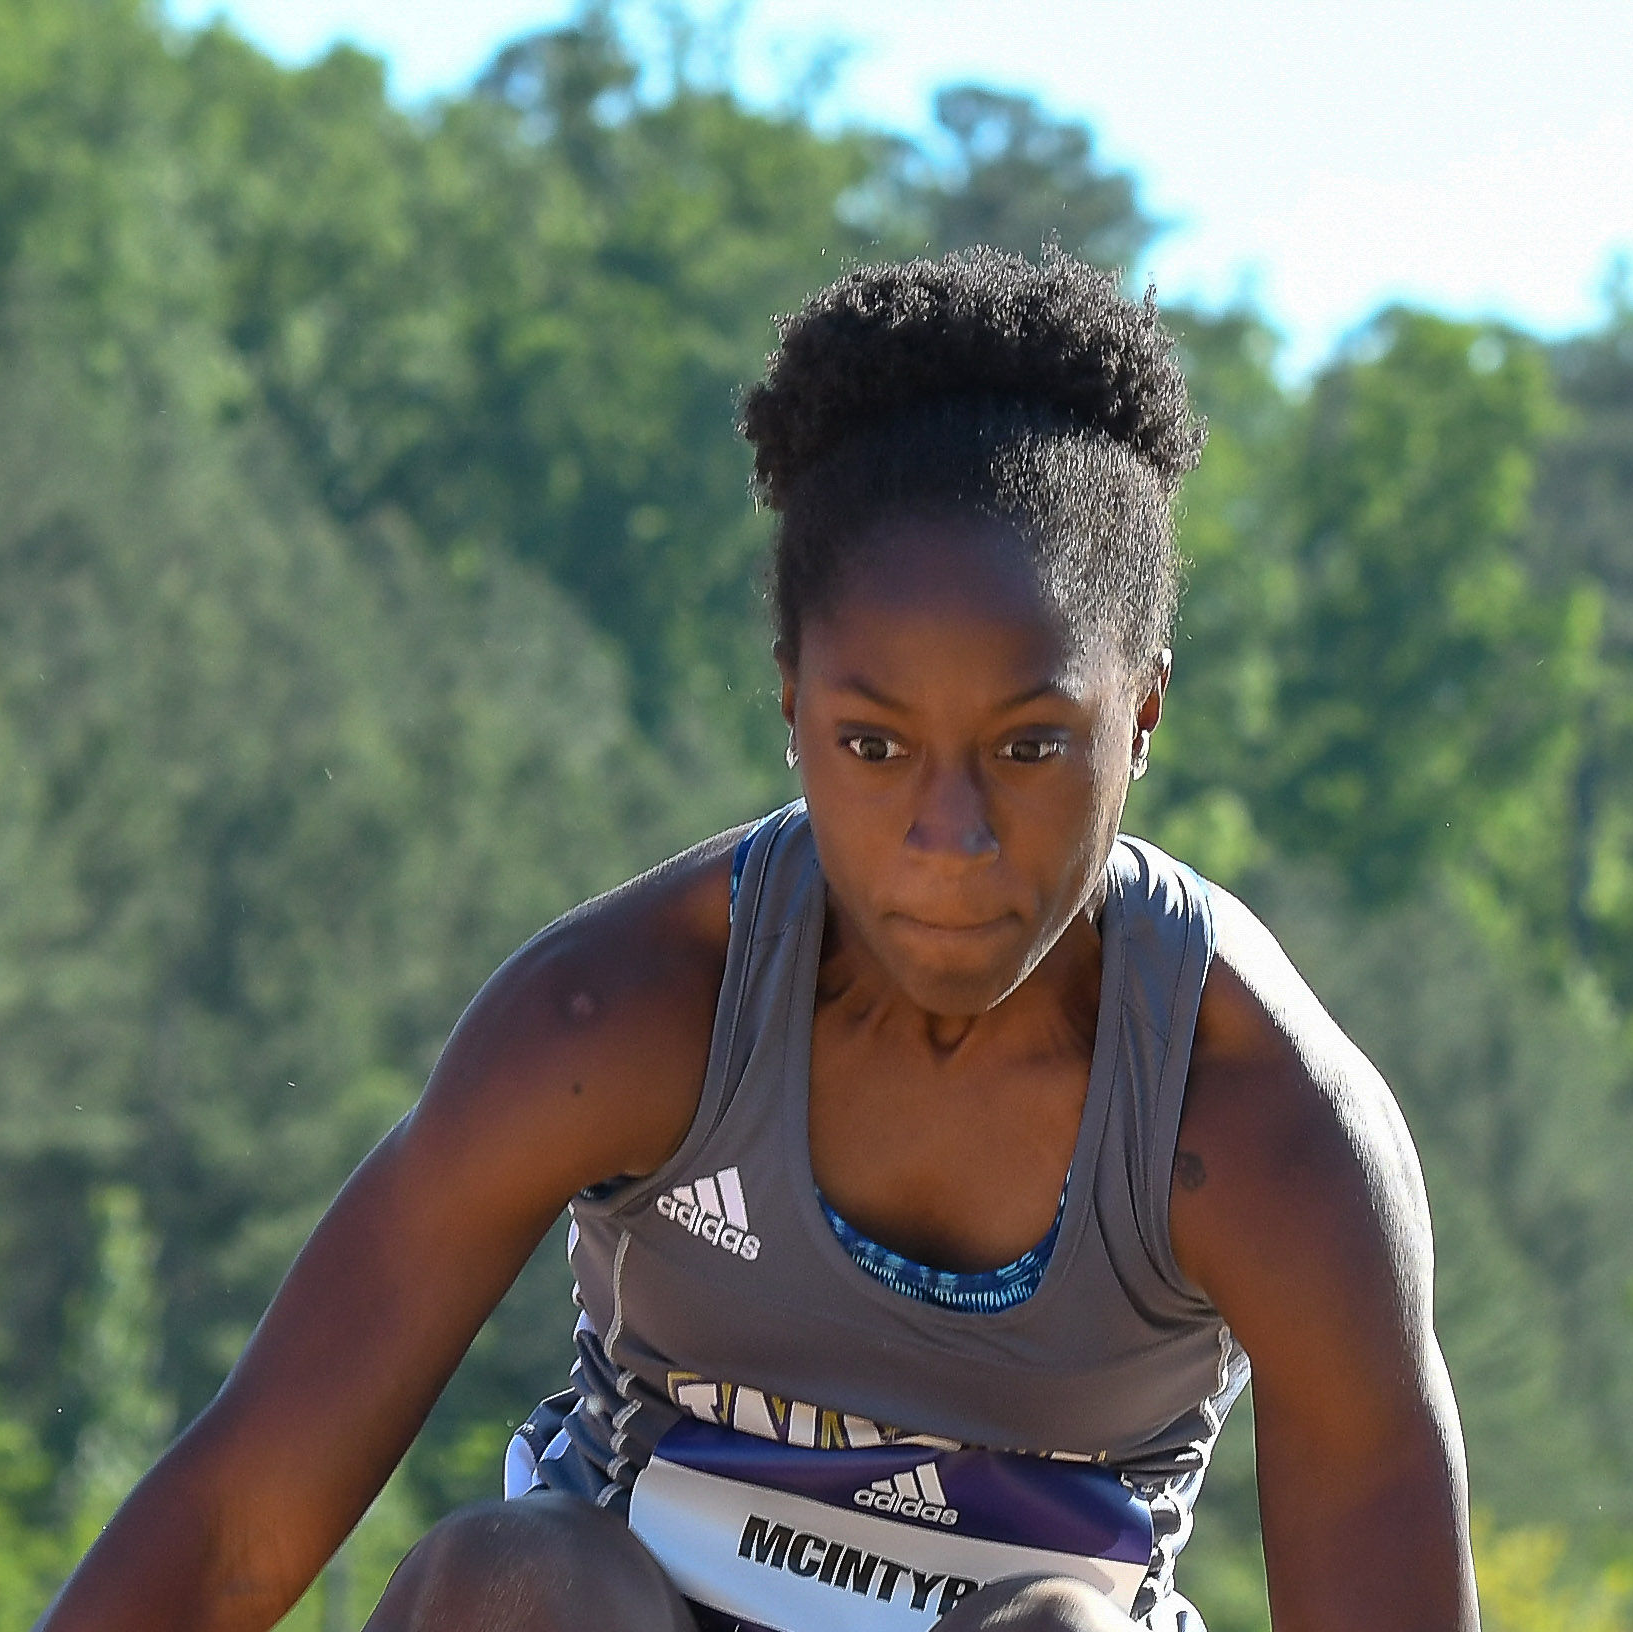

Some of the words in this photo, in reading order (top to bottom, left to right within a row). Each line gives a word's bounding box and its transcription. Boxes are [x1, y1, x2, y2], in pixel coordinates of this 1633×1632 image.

[656, 1194, 761, 1261] adidas
[853, 1488, 959, 1526] adidas
[737, 1513, 981, 1617] MCINTYR
